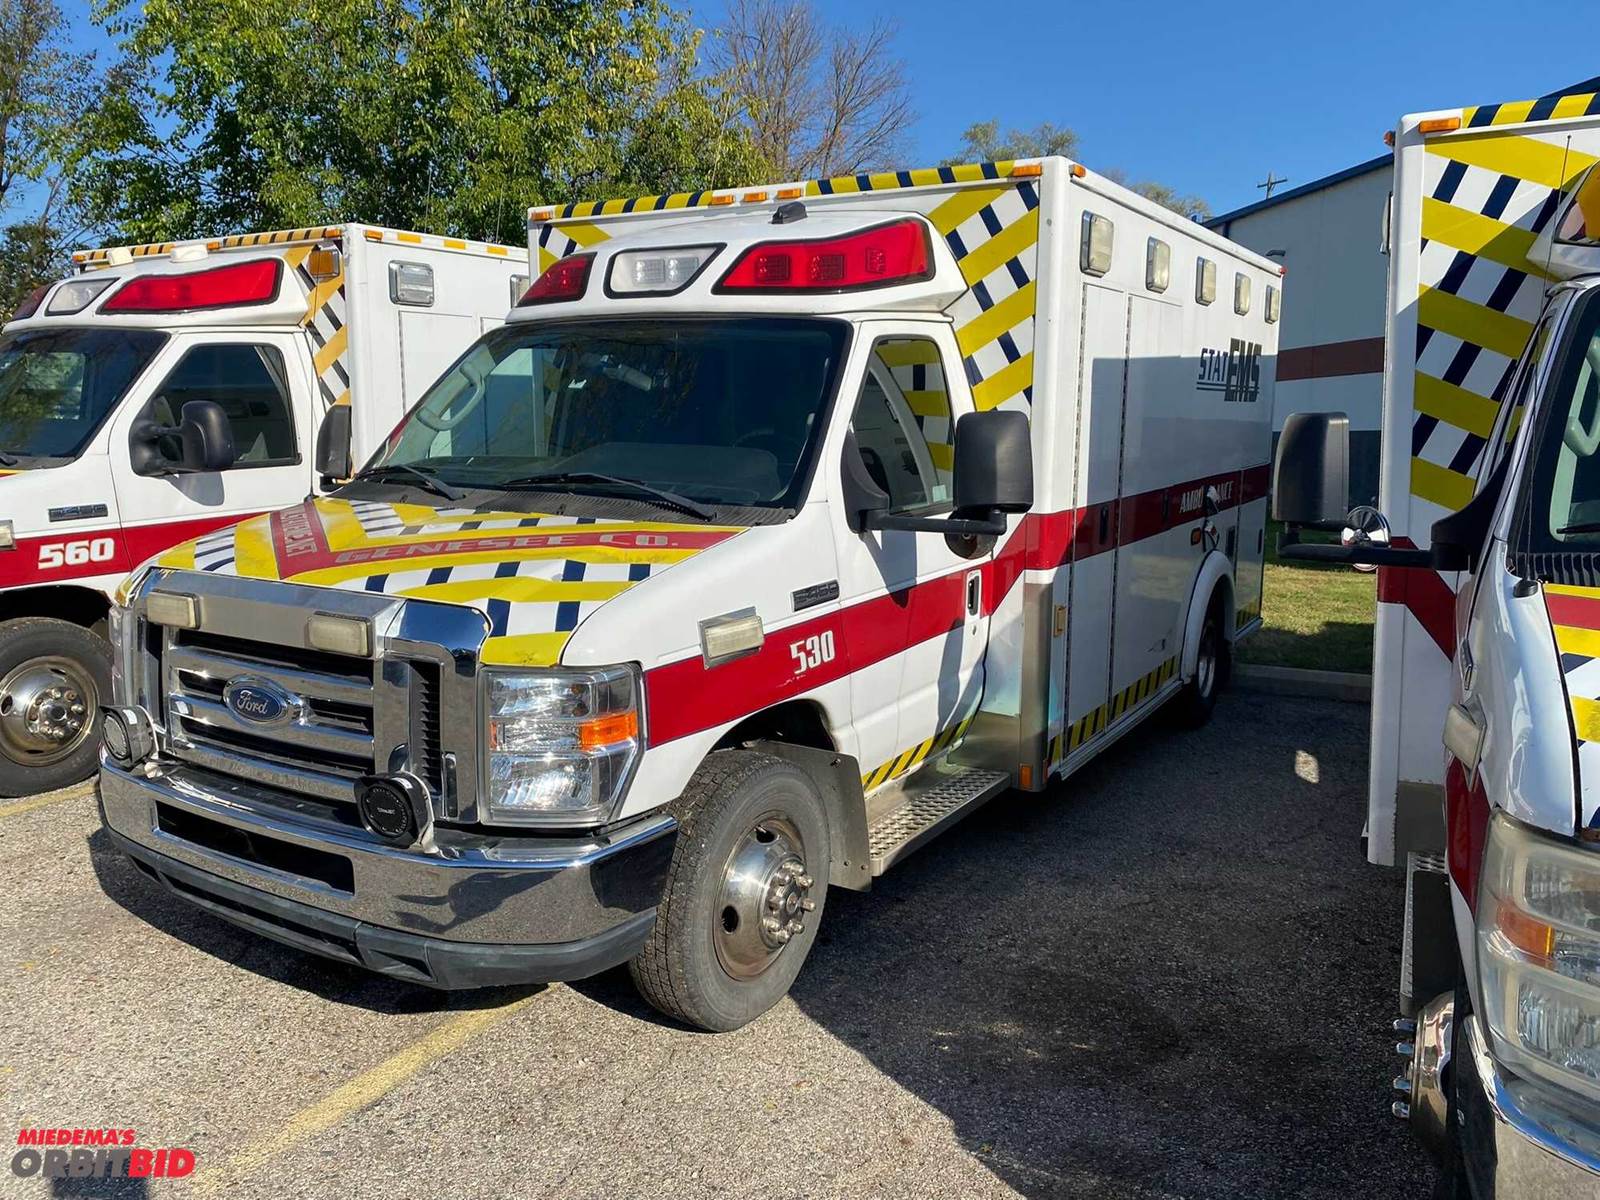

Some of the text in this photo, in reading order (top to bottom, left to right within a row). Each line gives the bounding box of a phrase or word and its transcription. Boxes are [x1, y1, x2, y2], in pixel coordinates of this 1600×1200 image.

[1198, 337, 1263, 403] STAT EMS
[1179, 481, 1234, 514] AMBUNCE
[37, 537, 115, 570] 560
[335, 533, 679, 564] GENESEE CO.
[789, 630, 836, 675] 530
[236, 689, 269, 715] Ford
